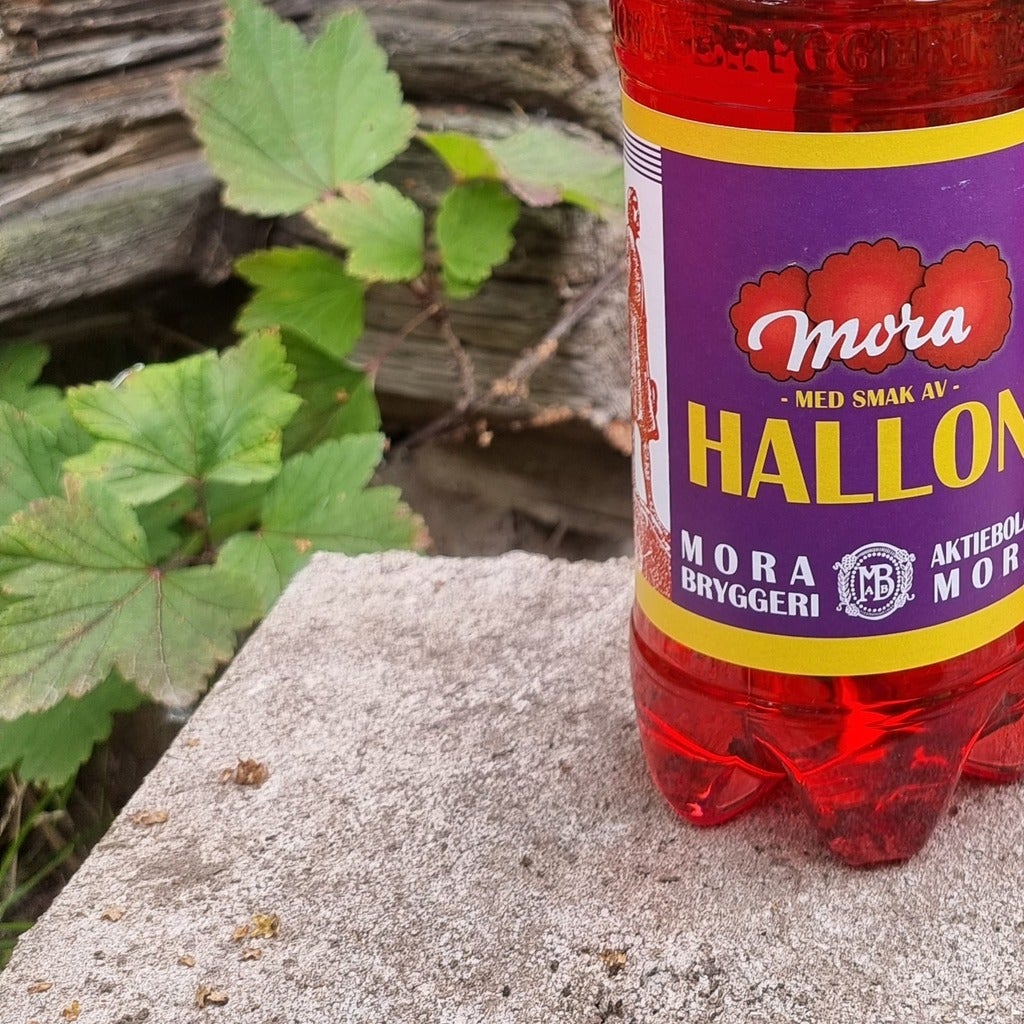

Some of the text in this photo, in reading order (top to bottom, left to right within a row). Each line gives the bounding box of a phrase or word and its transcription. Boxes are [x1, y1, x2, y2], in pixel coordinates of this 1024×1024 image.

[795, 380, 948, 408] MED SMAK AV
[681, 529, 816, 588] MORA
[681, 565, 820, 618] BRYGGERI
